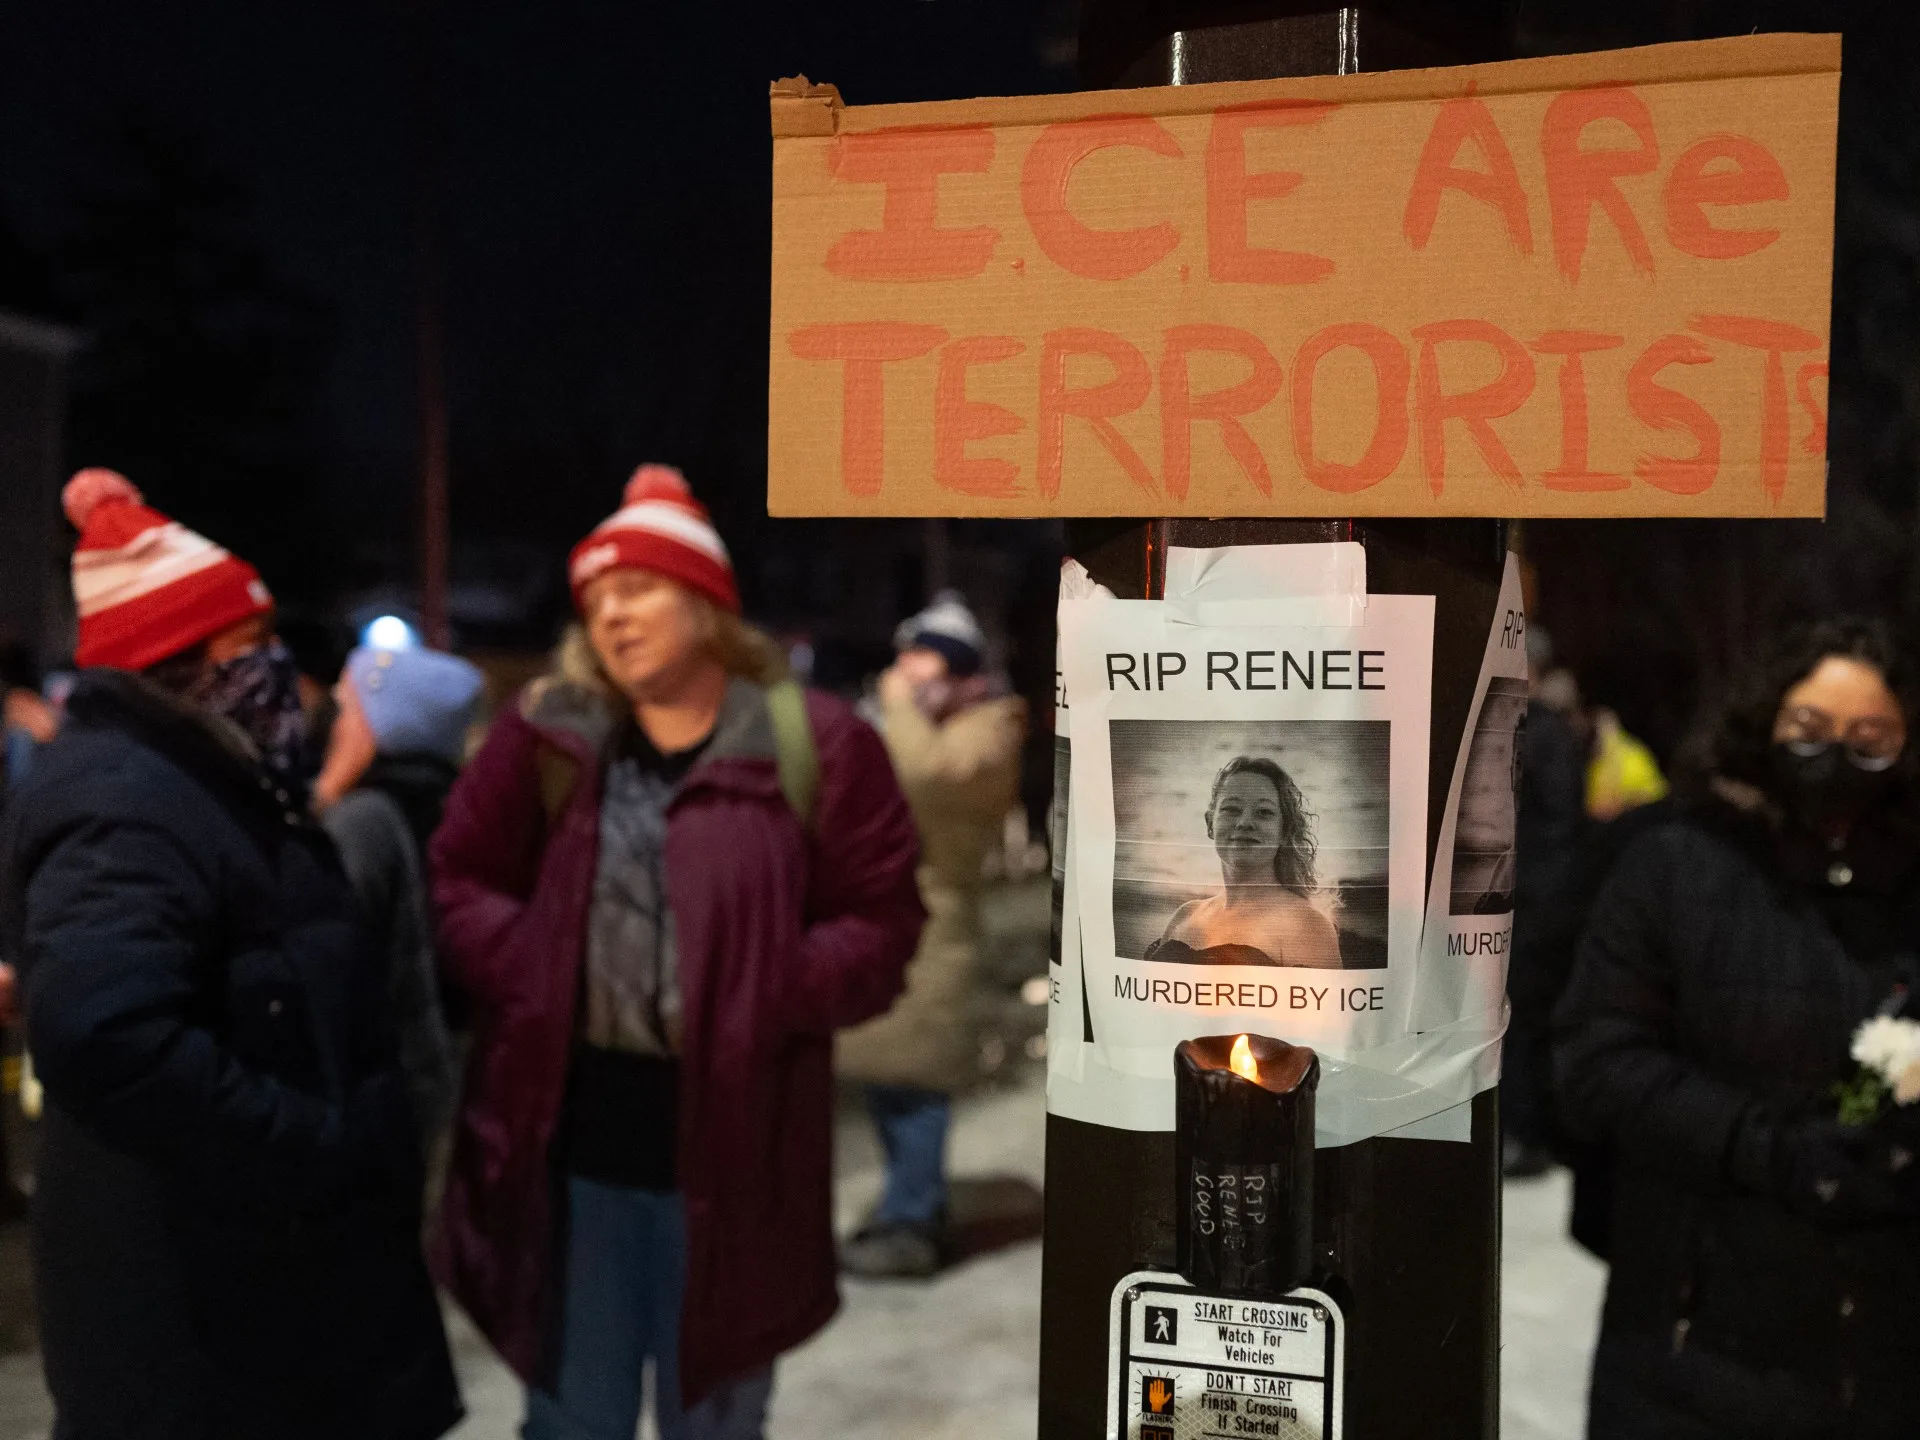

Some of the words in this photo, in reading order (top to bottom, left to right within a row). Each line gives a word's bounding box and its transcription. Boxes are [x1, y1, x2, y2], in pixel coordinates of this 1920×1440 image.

[824, 98, 1345, 284] ICE
[1403, 79, 1790, 285] ARe
[1501, 609, 1524, 650] RIP
[1106, 652, 1187, 692] RIP
[1206, 650, 1386, 691] RENEE
[1114, 974, 1278, 1009] MURDERED
[1289, 986, 1329, 1011] BY
[1340, 986, 1385, 1012] ICE
[1244, 1175, 1266, 1225] RIP
[1194, 1303, 1234, 1322] START
[1242, 1307, 1309, 1329] CROSSING
[1218, 1326, 1255, 1345] Watch
[1263, 1331, 1283, 1348] For
[1225, 1346, 1275, 1366] Vehicles
[1206, 1372, 1246, 1392] DON'T
[1254, 1379, 1293, 1398] START
[1201, 1393, 1237, 1412] Finish
[1246, 1399, 1298, 1422] Crossing
[1218, 1414, 1228, 1430] If
[1235, 1417, 1279, 1436] Started
